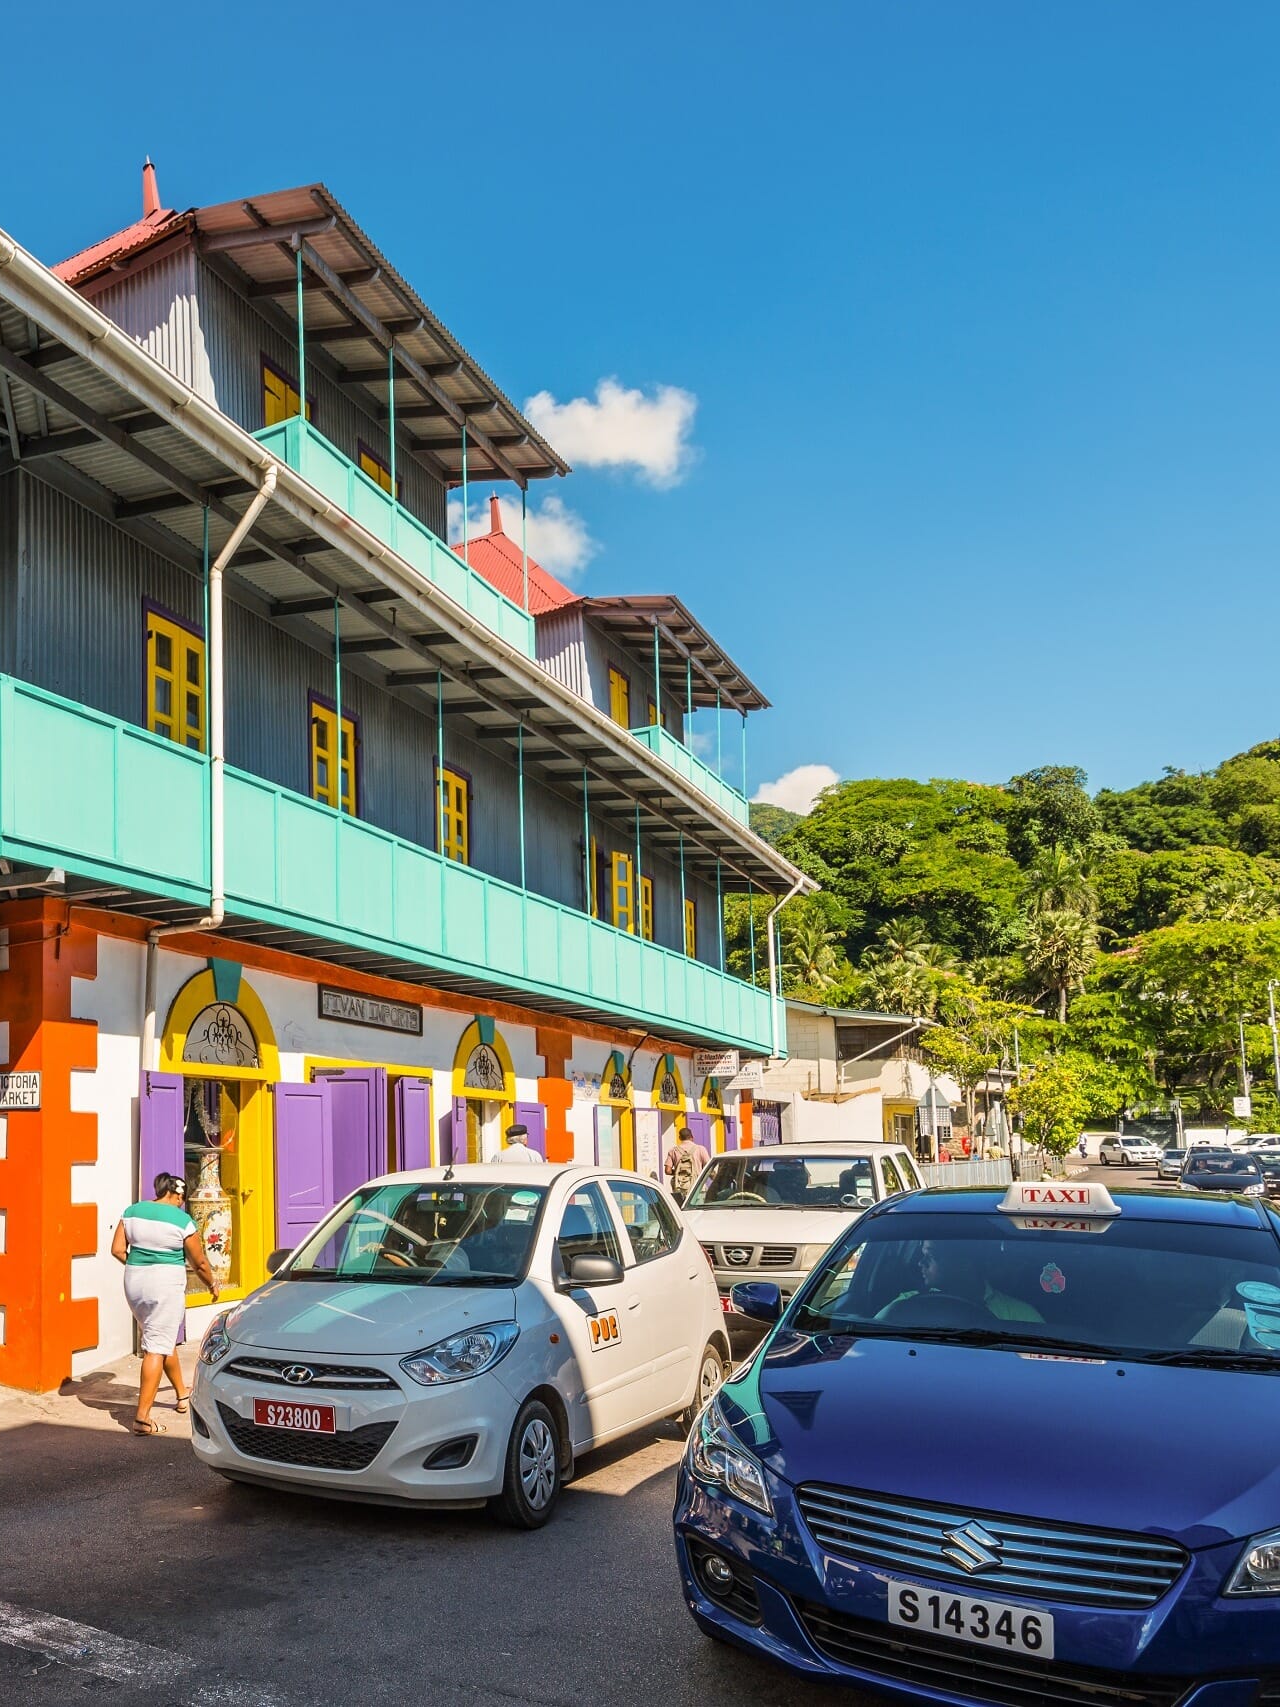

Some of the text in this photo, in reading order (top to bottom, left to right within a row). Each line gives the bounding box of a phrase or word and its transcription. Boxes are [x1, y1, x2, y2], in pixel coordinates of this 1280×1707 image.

[323, 992, 418, 1029] JIVAN IMPORTS
[1024, 1189, 1087, 1204] TAXI
[267, 1404, 321, 1430] S23800
[898, 1589, 1043, 1650] S14346
